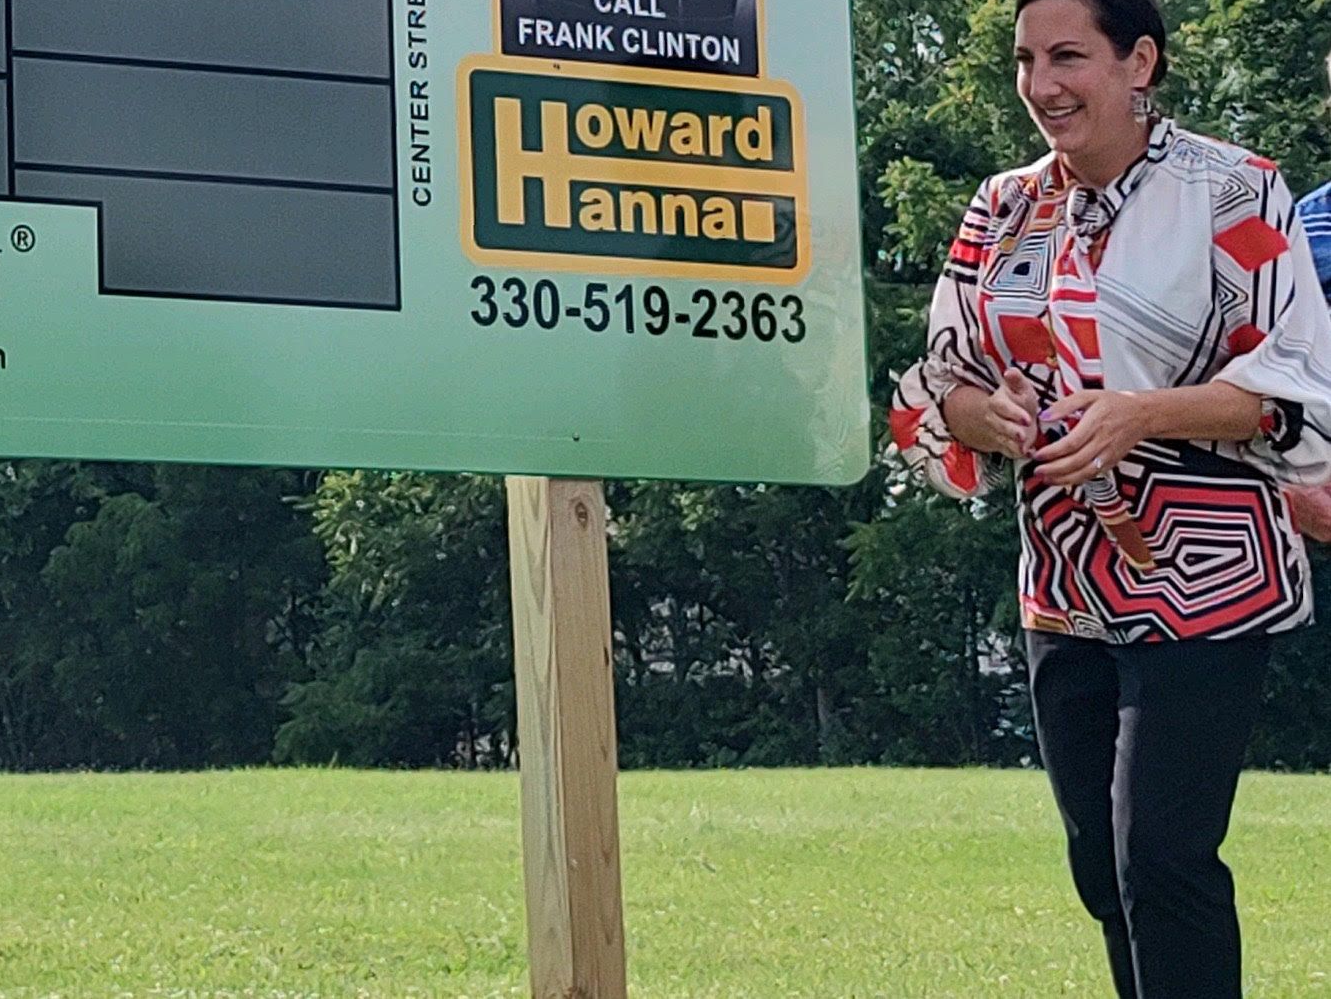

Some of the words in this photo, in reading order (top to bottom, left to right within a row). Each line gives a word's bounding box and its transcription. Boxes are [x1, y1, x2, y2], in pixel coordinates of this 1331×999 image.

[518, 17, 615, 52] FRANK
[621, 27, 740, 65] CLINTON
[409, 80, 432, 207] CENTER
[493, 96, 773, 177] Howard
[495, 157, 740, 242] Hanna
[470, 275, 806, 344] 330-519-2363
